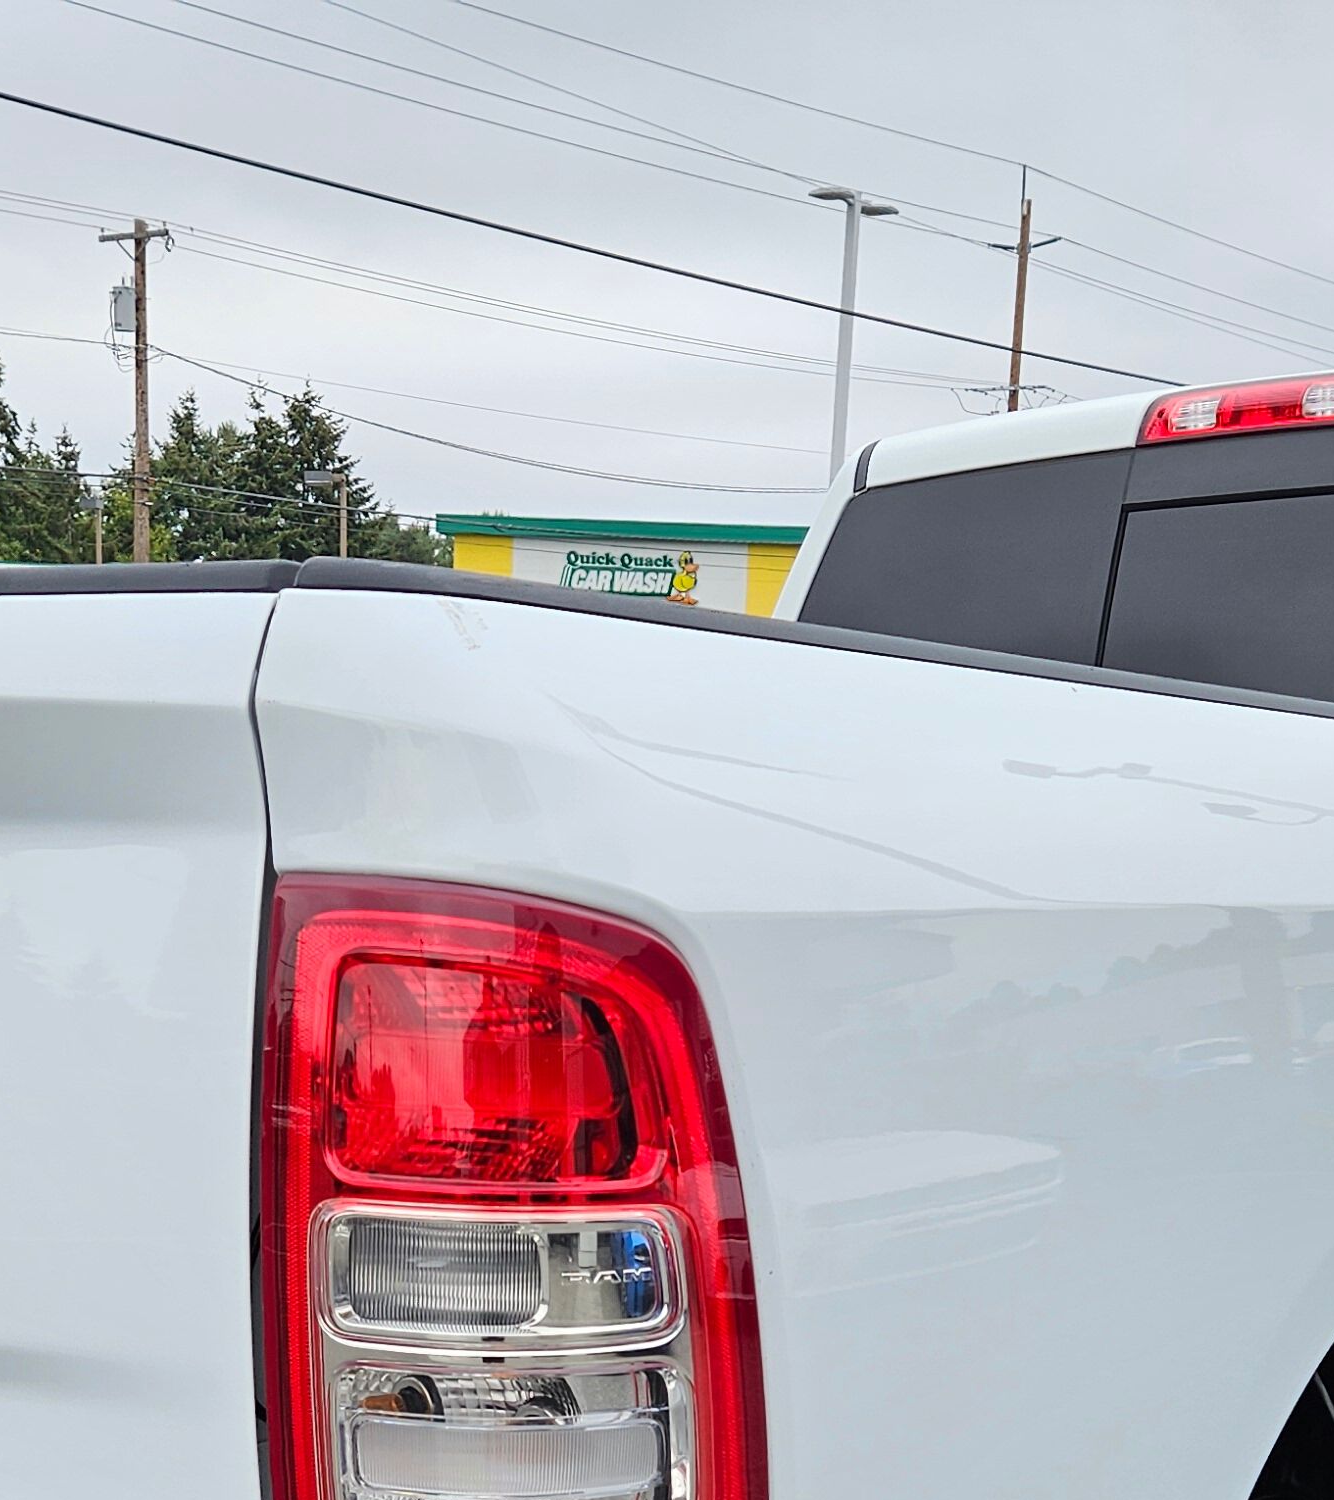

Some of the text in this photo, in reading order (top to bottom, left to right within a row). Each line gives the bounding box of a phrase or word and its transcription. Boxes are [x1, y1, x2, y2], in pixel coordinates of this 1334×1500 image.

[567, 550, 673, 568] Quick Quack
[571, 568, 673, 595] CAR WASH
[561, 1267, 652, 1286] RAM
